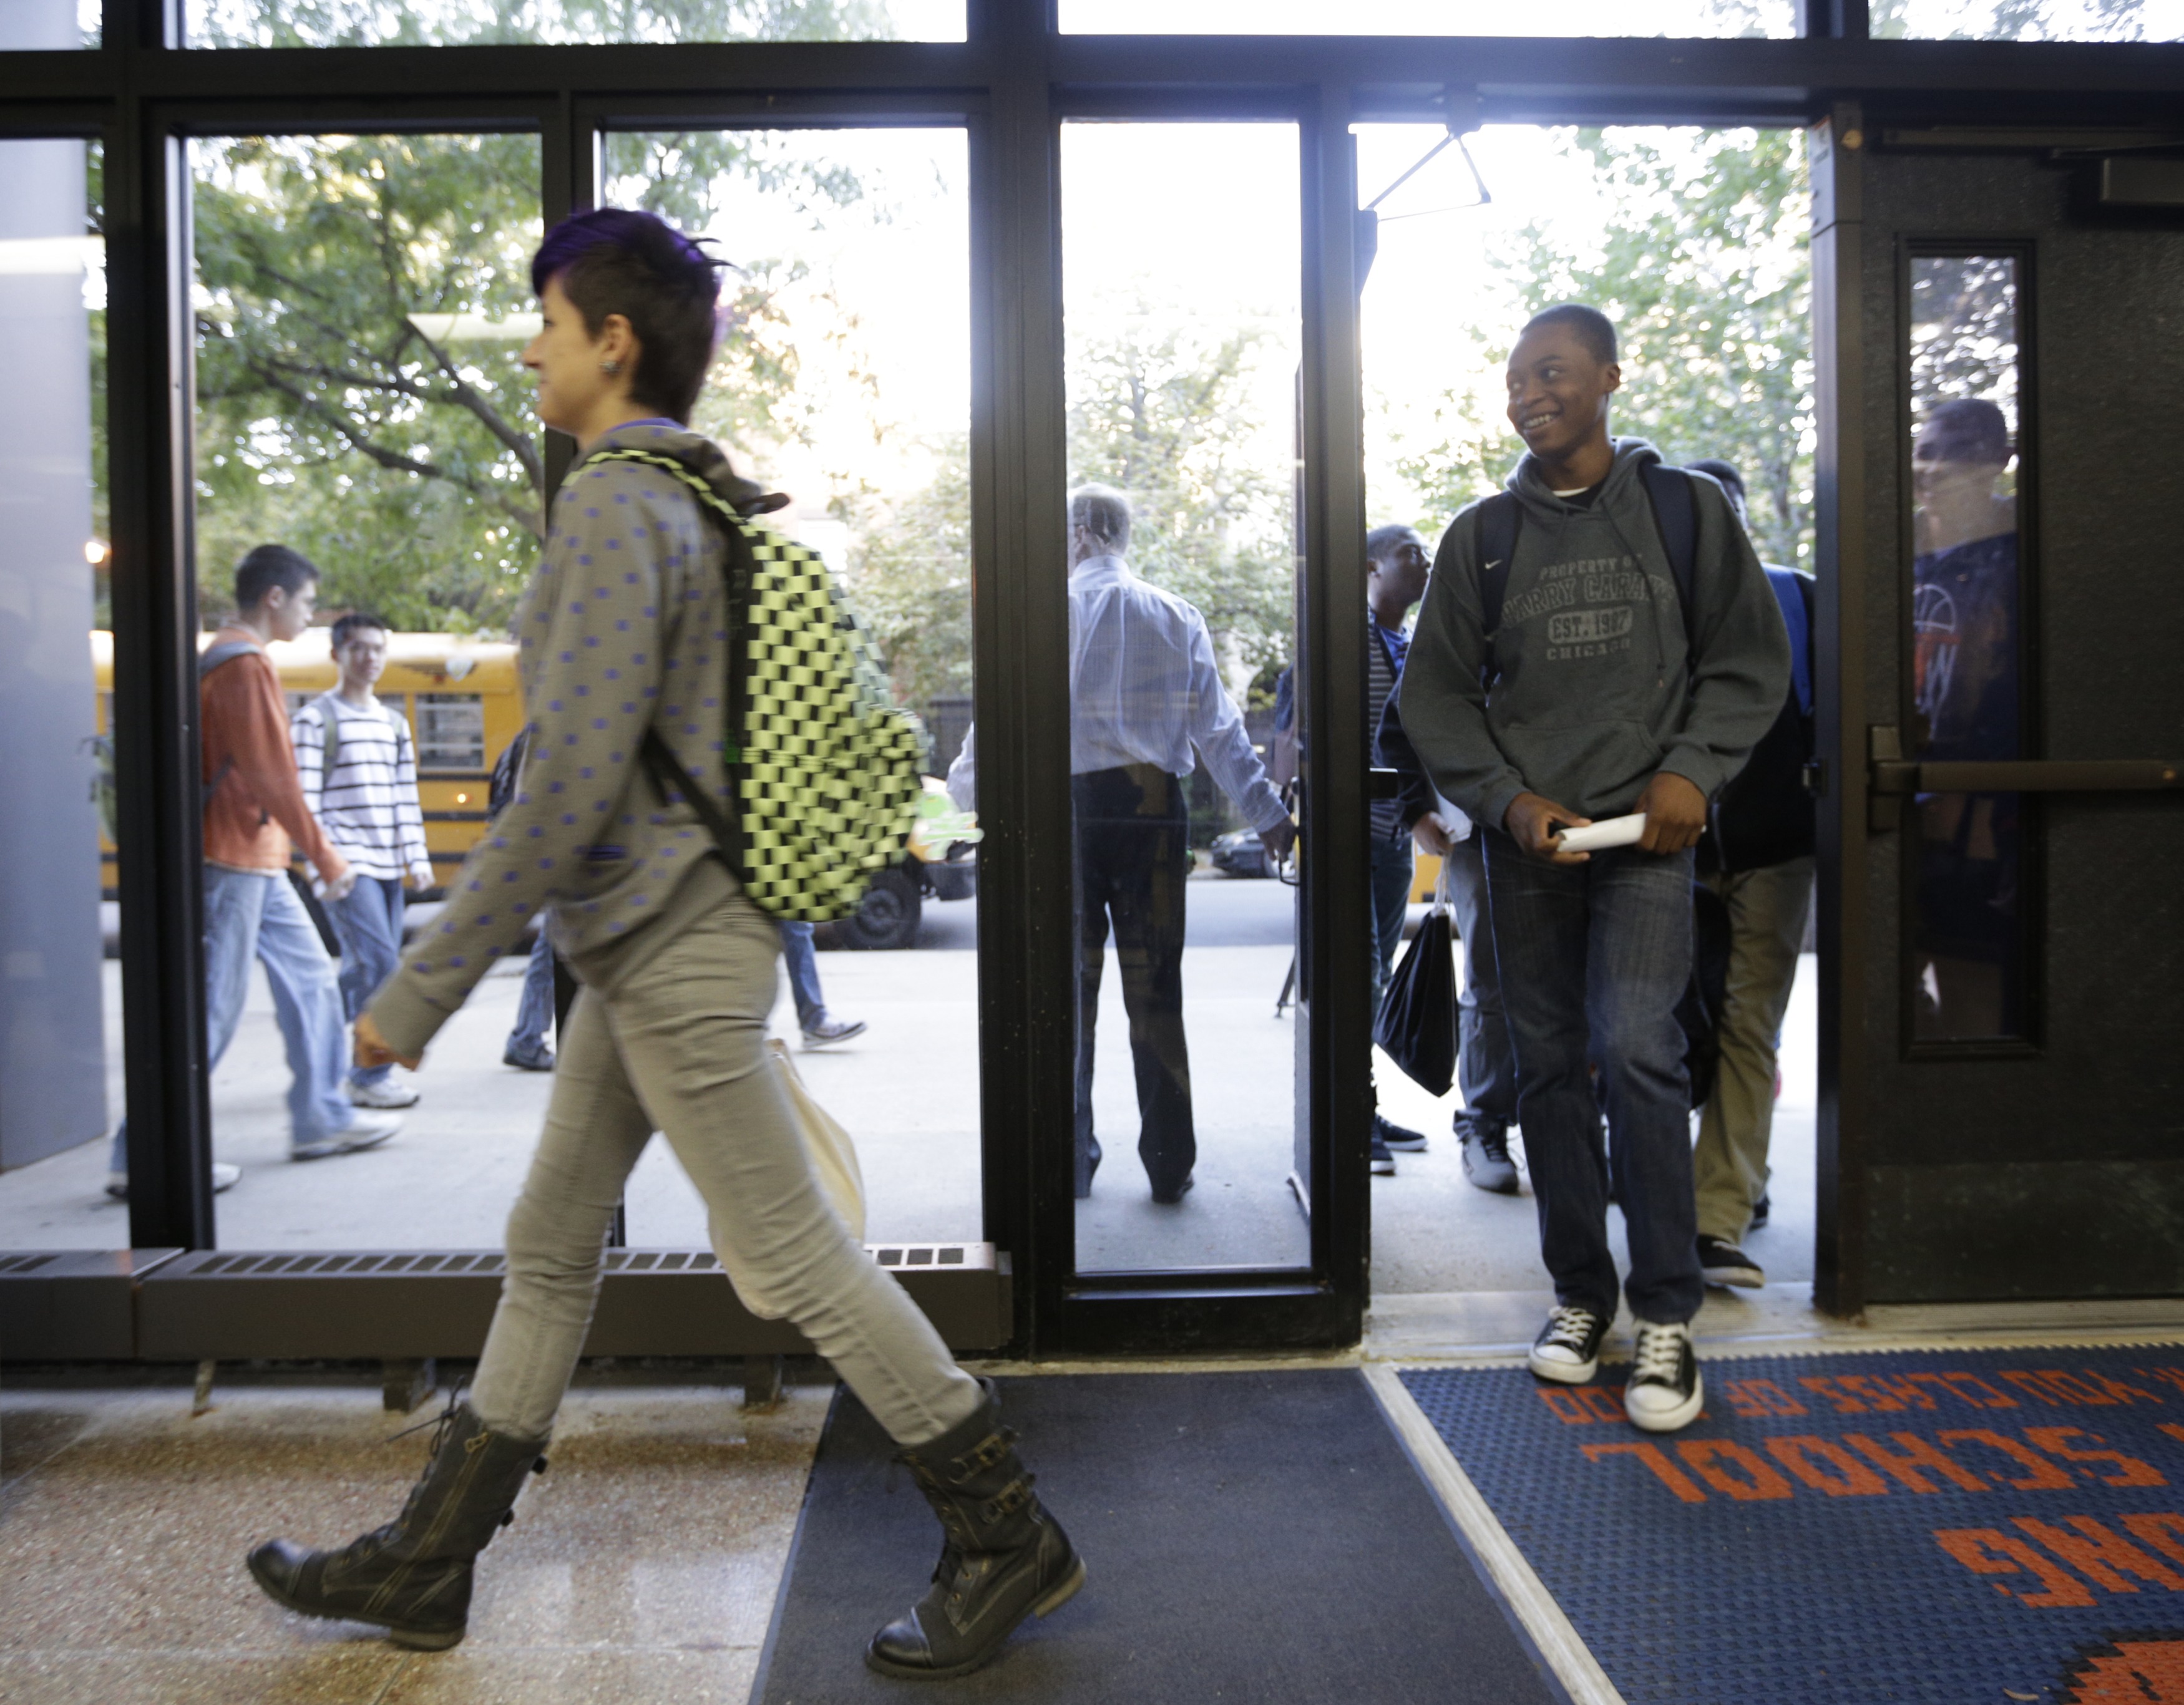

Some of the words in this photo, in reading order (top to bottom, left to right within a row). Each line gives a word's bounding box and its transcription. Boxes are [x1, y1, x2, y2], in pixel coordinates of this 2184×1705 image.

[1539, 557, 1617, 581] PROPERTY
[1552, 614, 1589, 639] EST.
[1546, 637, 1631, 661] CHICAGO
[1536, 1386, 1711, 1424] 00
[1726, 1379, 1808, 1417] OF
[1798, 1372, 2020, 1413] CLASS
[1999, 1369, 2163, 1405] YOU
[1579, 1426, 2170, 1503] SCHOOL
